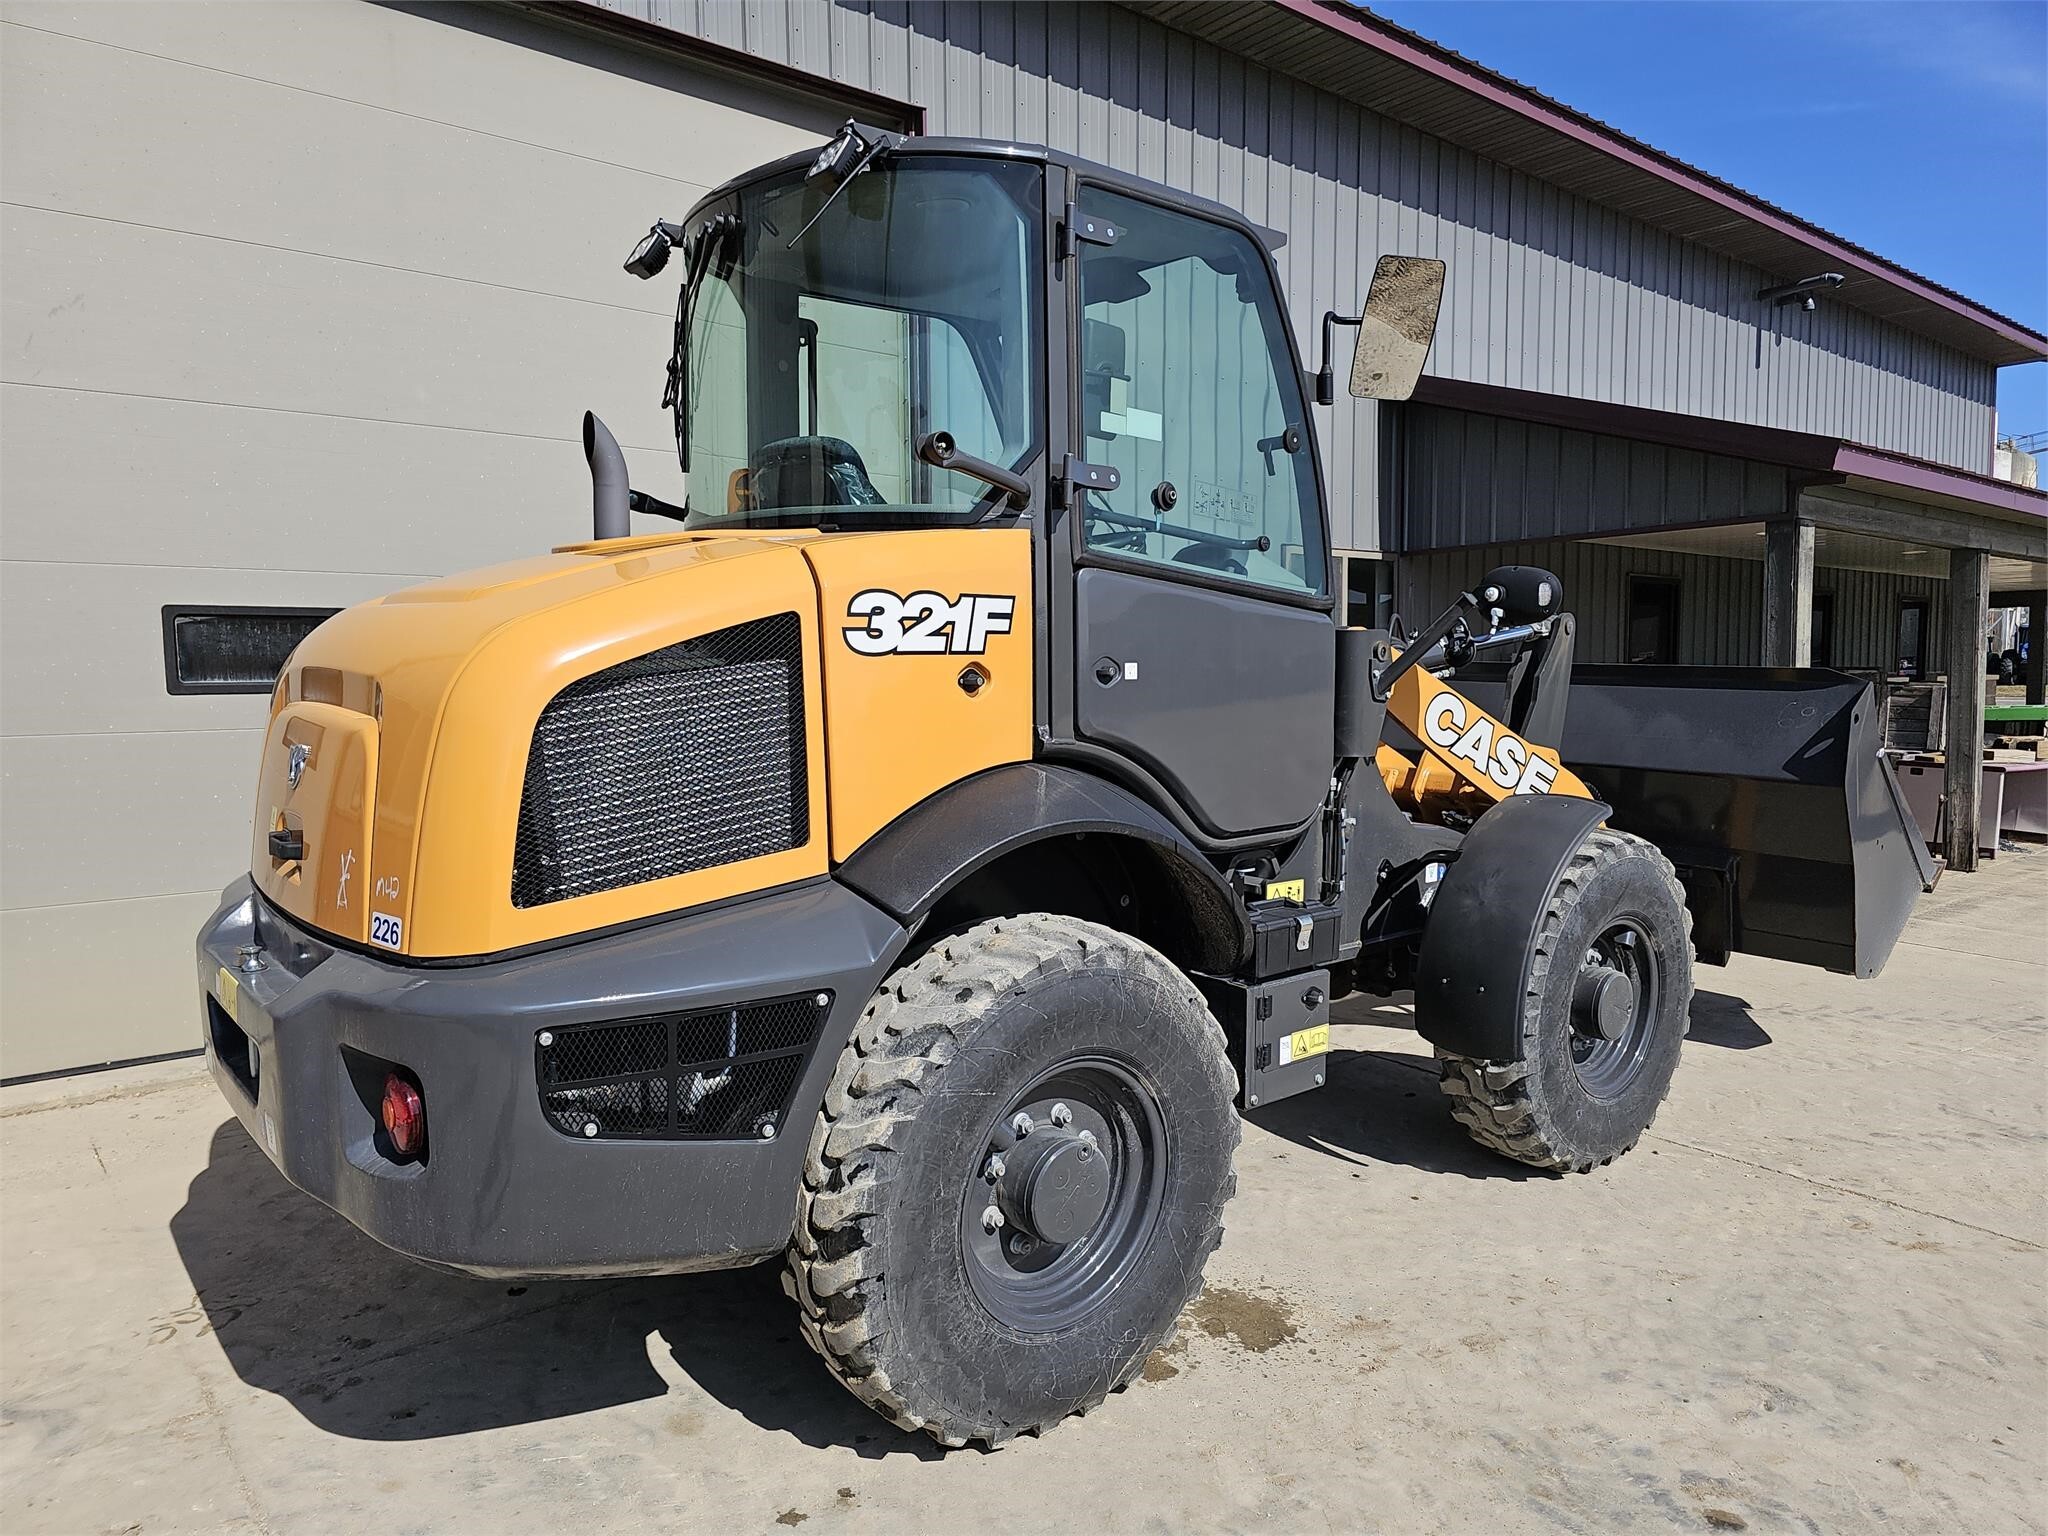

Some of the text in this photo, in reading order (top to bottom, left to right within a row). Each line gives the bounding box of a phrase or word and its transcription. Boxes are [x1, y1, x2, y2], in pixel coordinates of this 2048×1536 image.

[842, 589, 1016, 657] 321F
[1424, 691, 1559, 796] CASE
[372, 916, 400, 946] 226
